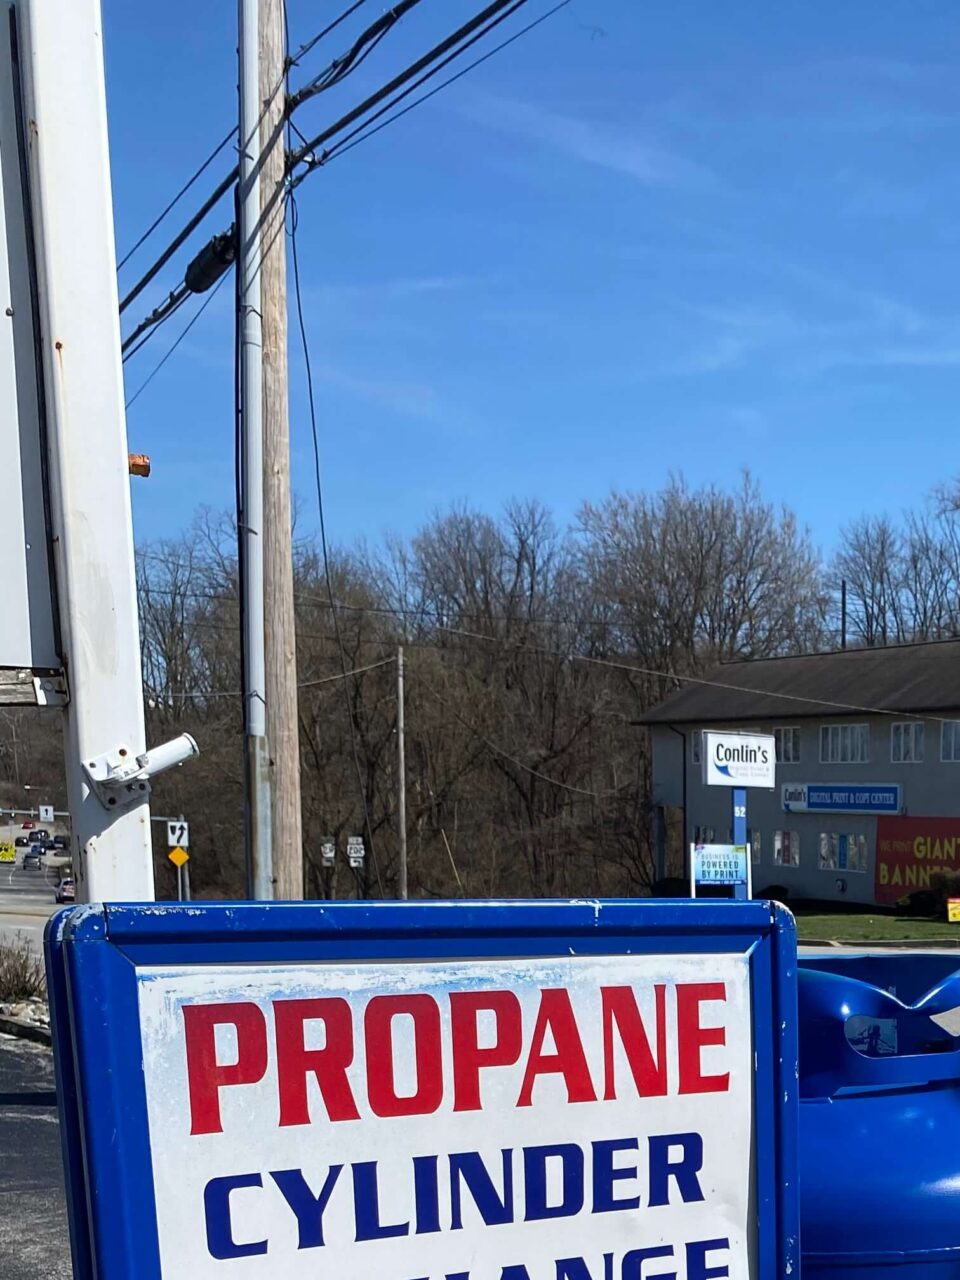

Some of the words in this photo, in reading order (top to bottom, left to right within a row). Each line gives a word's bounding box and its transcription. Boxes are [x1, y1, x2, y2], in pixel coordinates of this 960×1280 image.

[716, 743, 769, 764] Conlin's
[734, 806, 746, 817] 52
[701, 861, 739, 869] POWERED
[701, 870, 711, 879] BY
[181, 982, 731, 1136] PROPANE
[203, 1132, 705, 1260] CYLINDER
